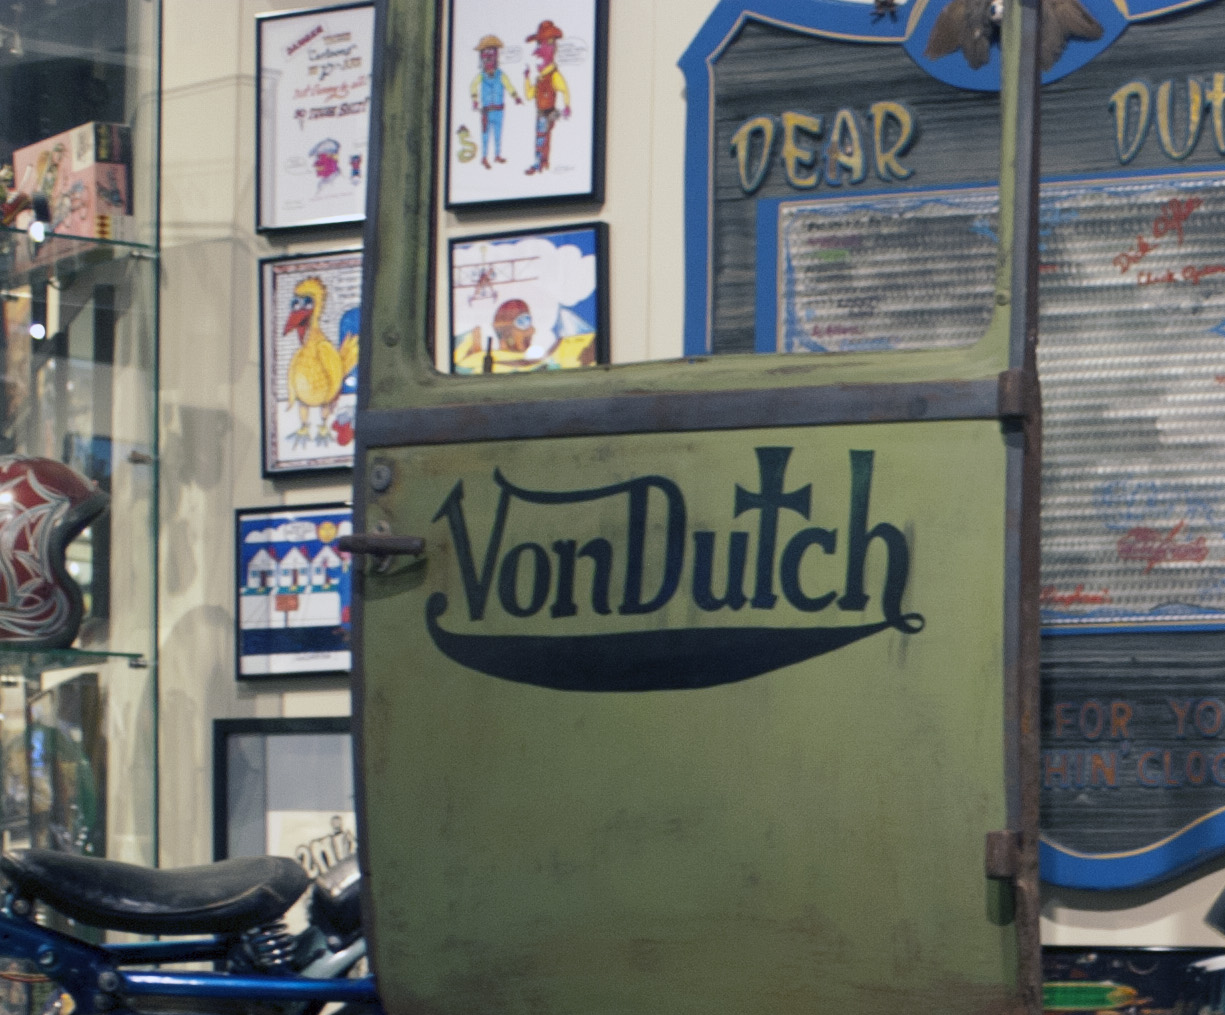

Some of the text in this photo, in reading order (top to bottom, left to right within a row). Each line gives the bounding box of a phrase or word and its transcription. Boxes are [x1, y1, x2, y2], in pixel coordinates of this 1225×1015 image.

[730, 101, 915, 194] DEAR
[428, 446, 925, 636] VonDutch
[1053, 698, 1134, 740] FOR
